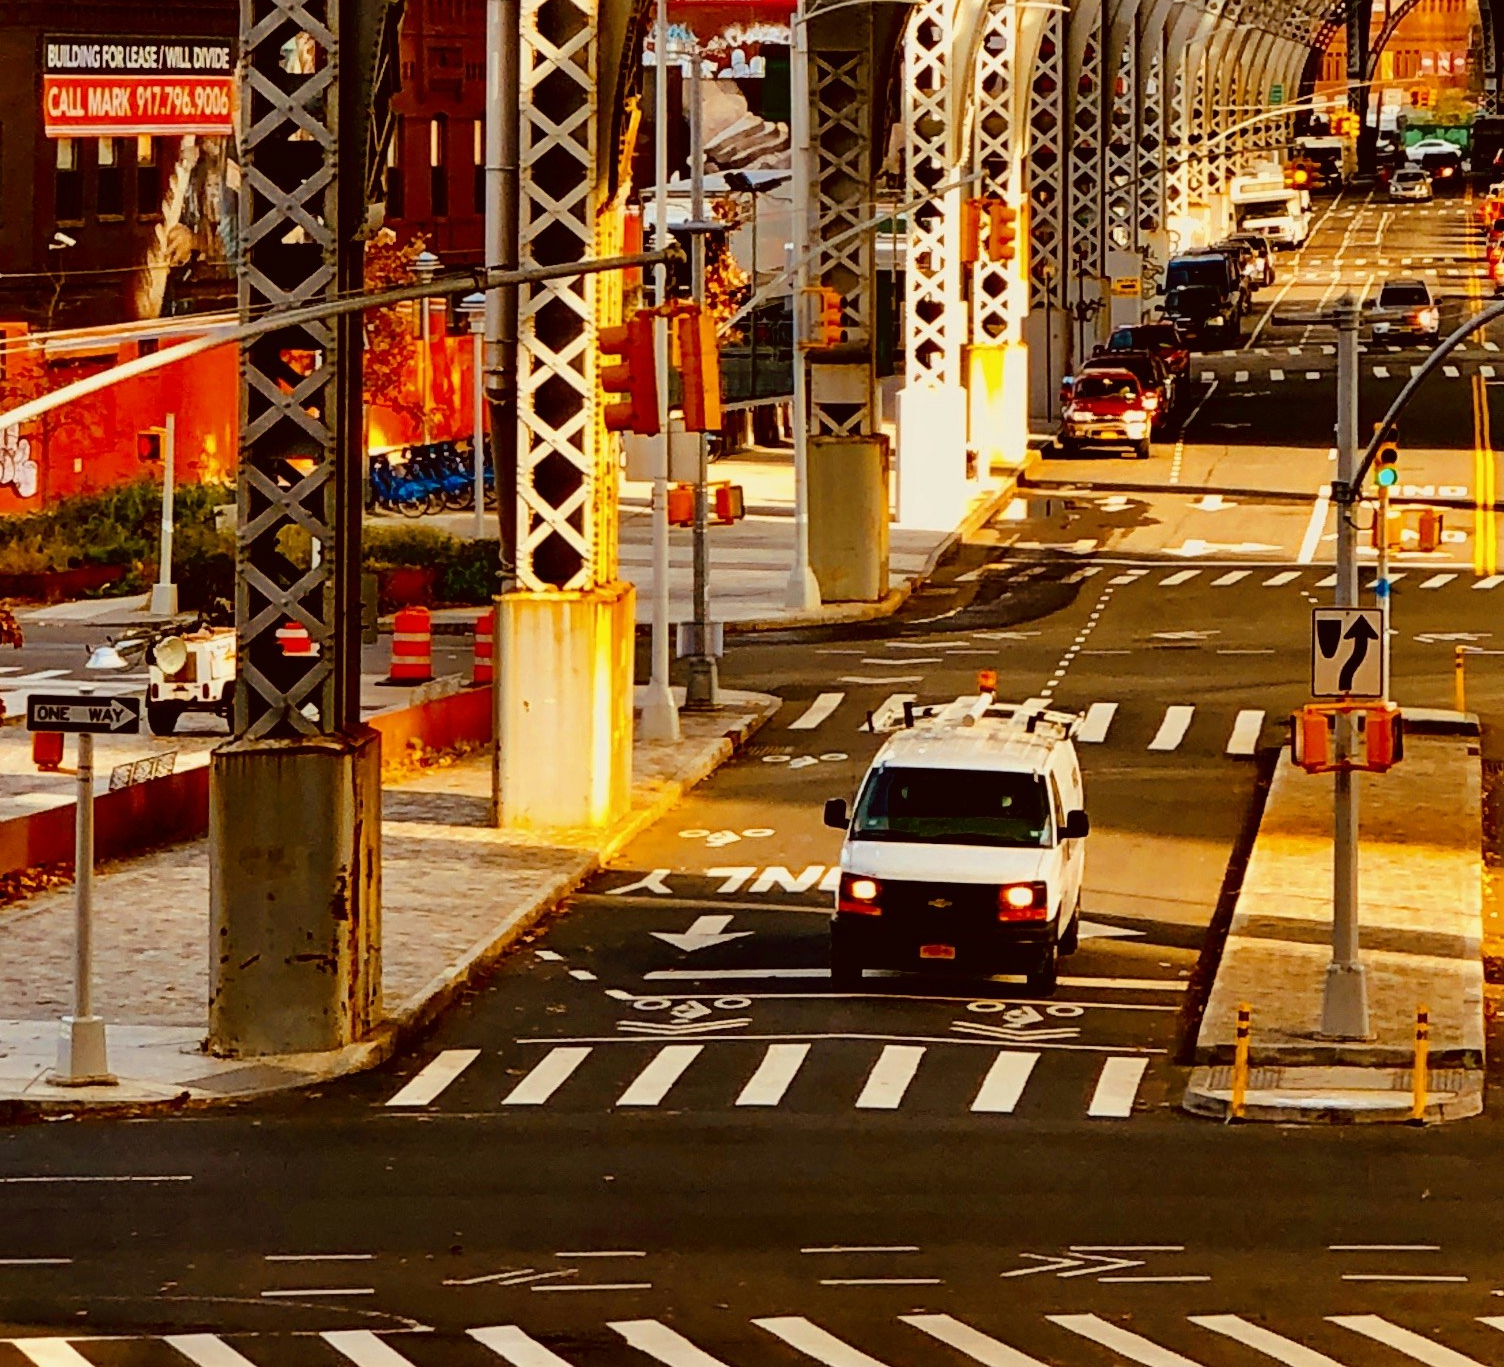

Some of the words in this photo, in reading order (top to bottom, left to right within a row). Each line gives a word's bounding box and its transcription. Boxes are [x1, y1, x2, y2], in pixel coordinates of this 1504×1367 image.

[47, 44, 100, 68] BUILDING
[102, 45, 124, 68] FOR
[126, 46, 157, 68] LEASE
[165, 47, 192, 68] WILL
[193, 47, 230, 69] DIVIDE
[48, 86, 85, 118] CALL
[88, 87, 131, 117] MARK
[136, 86, 229, 116] 917.796.9006
[37, 706, 70, 721] ONE
[88, 708, 124, 722] WAY
[605, 865, 841, 895] NLY
